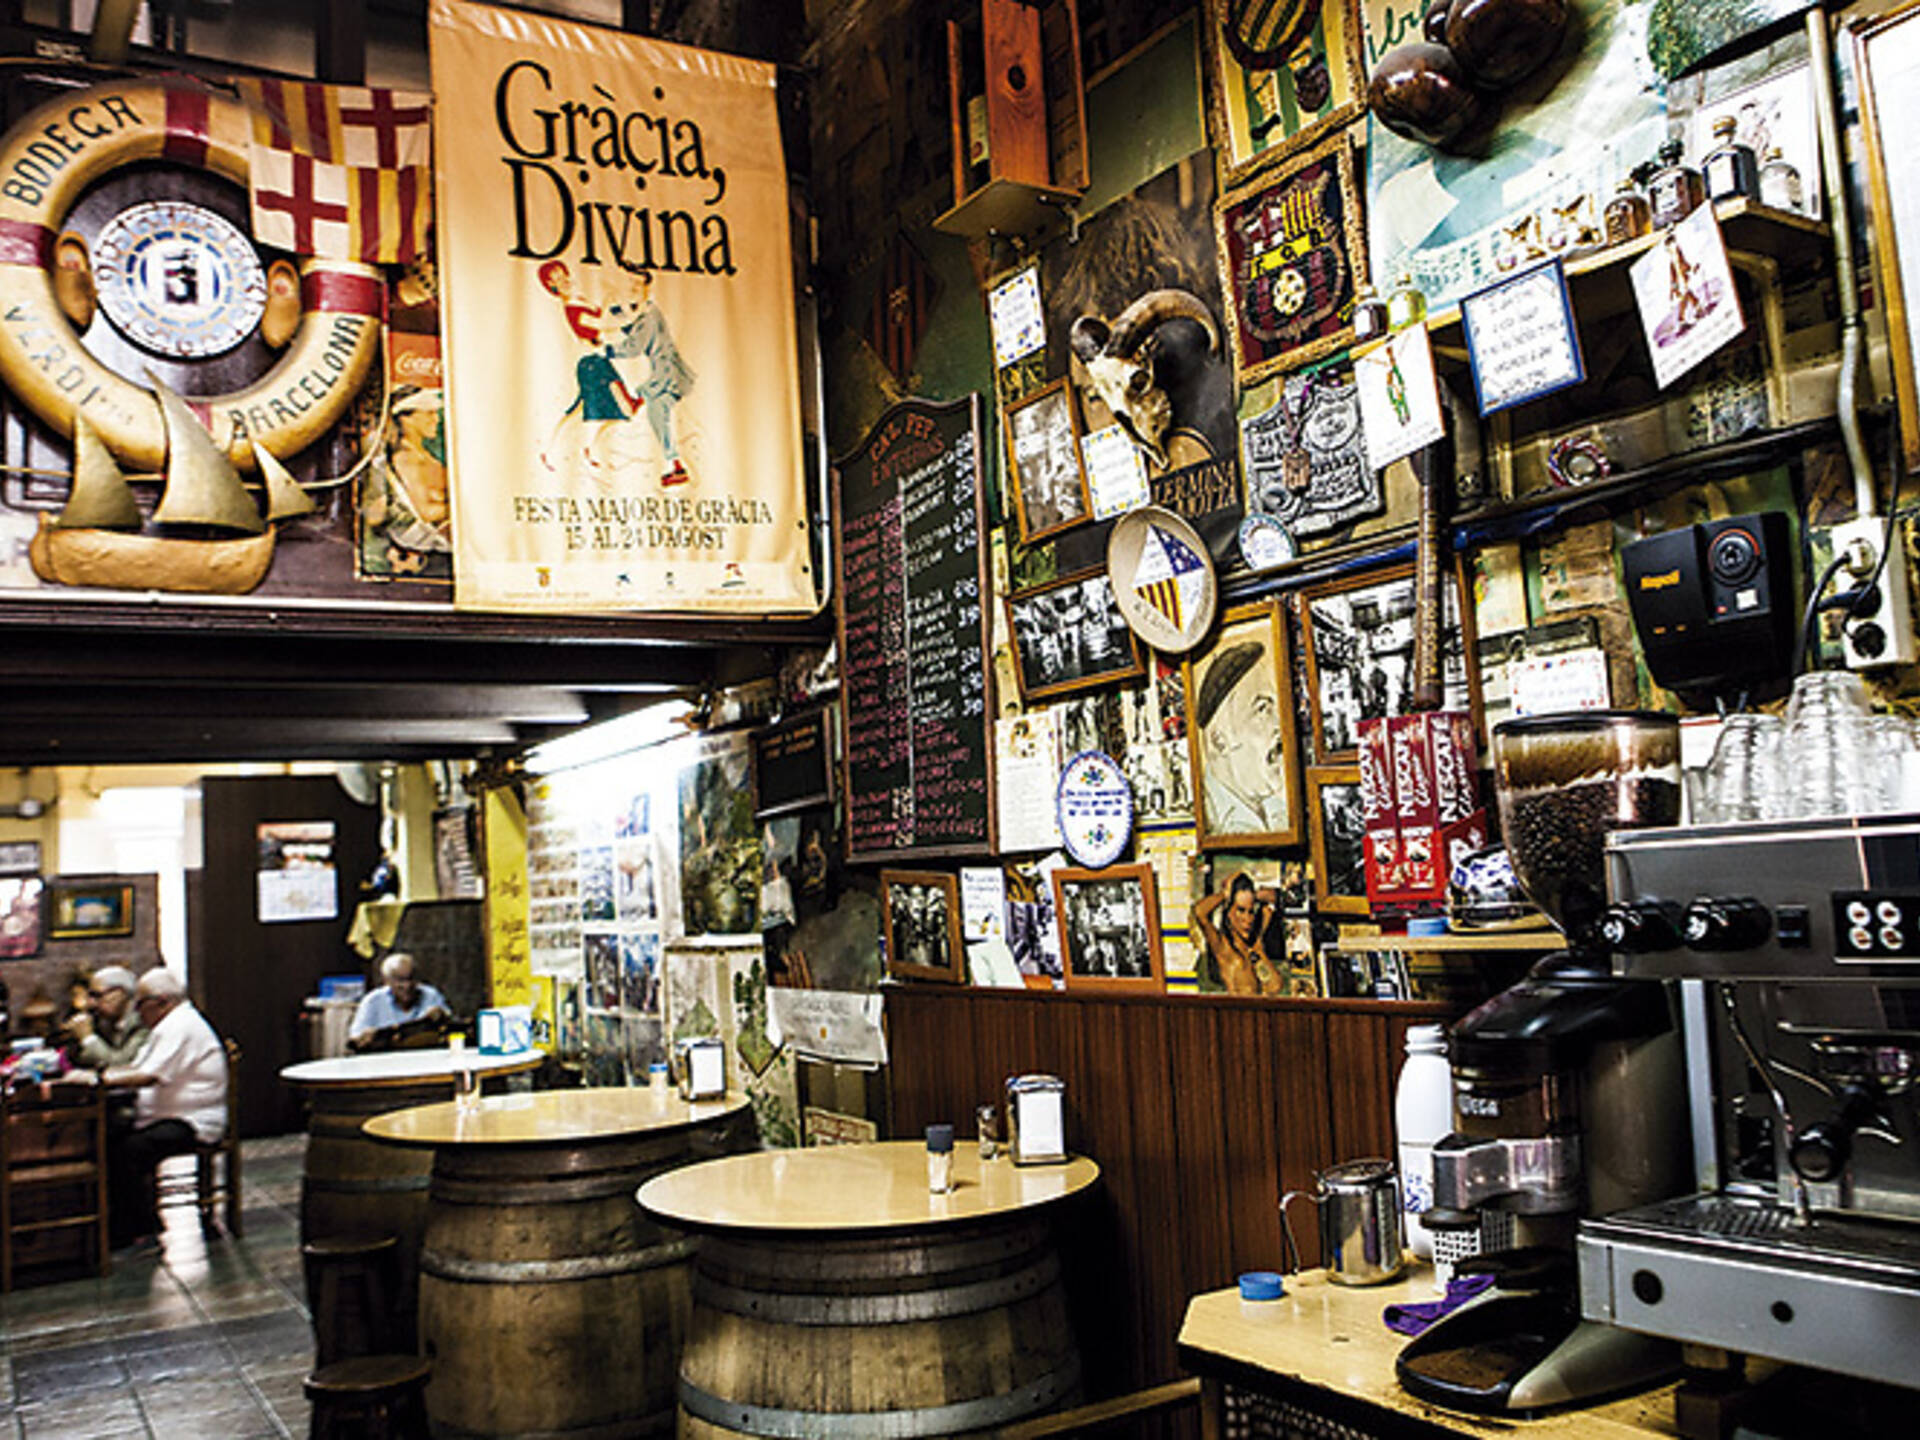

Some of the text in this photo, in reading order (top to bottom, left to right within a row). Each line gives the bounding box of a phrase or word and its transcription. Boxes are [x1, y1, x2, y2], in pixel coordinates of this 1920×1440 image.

[2, 95, 143, 206] BODEGA
[495, 60, 726, 206] Gràcia,
[501, 157, 738, 282] Divina
[228, 315, 365, 440] BARCELONA
[513, 497, 581, 522] FESTA
[586, 497, 660, 524] MAJOR
[663, 498, 693, 523] DE
[565, 525, 586, 550] 15
[591, 525, 618, 549] AL
